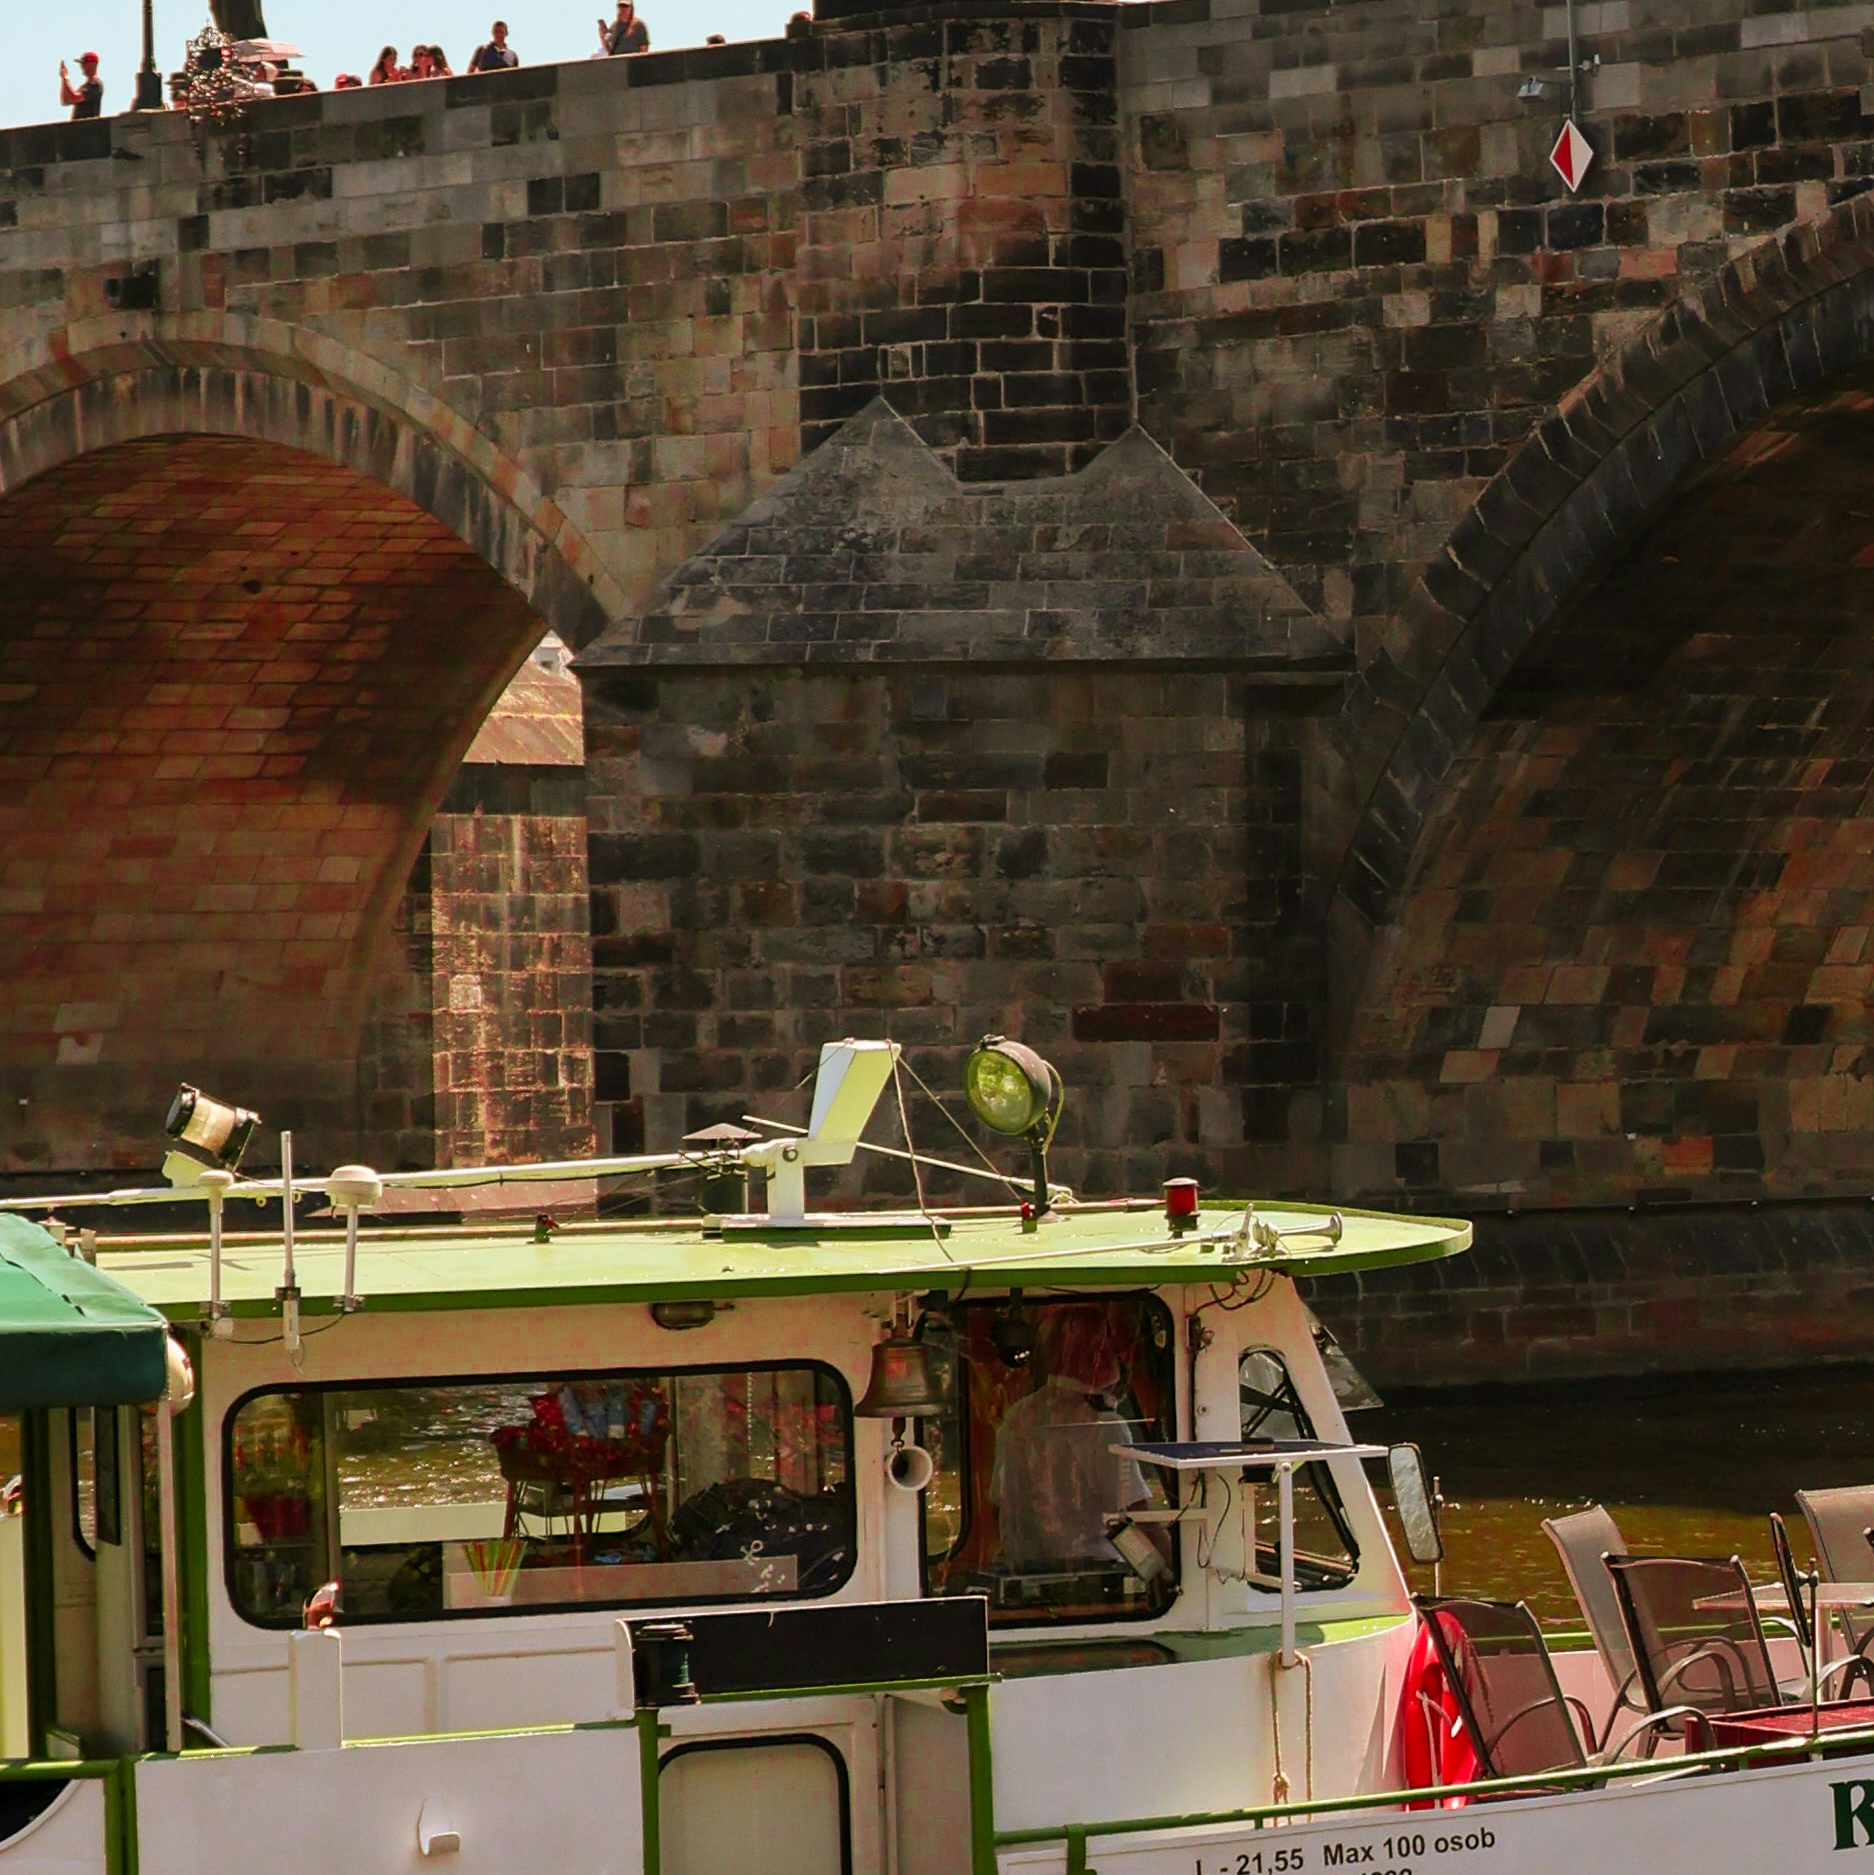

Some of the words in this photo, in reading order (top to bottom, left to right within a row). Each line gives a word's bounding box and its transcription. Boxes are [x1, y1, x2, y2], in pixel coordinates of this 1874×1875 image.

[1323, 1843, 1375, 1867] Max
[1382, 1834, 1426, 1860] 100
[1433, 1827, 1496, 1854] osob
